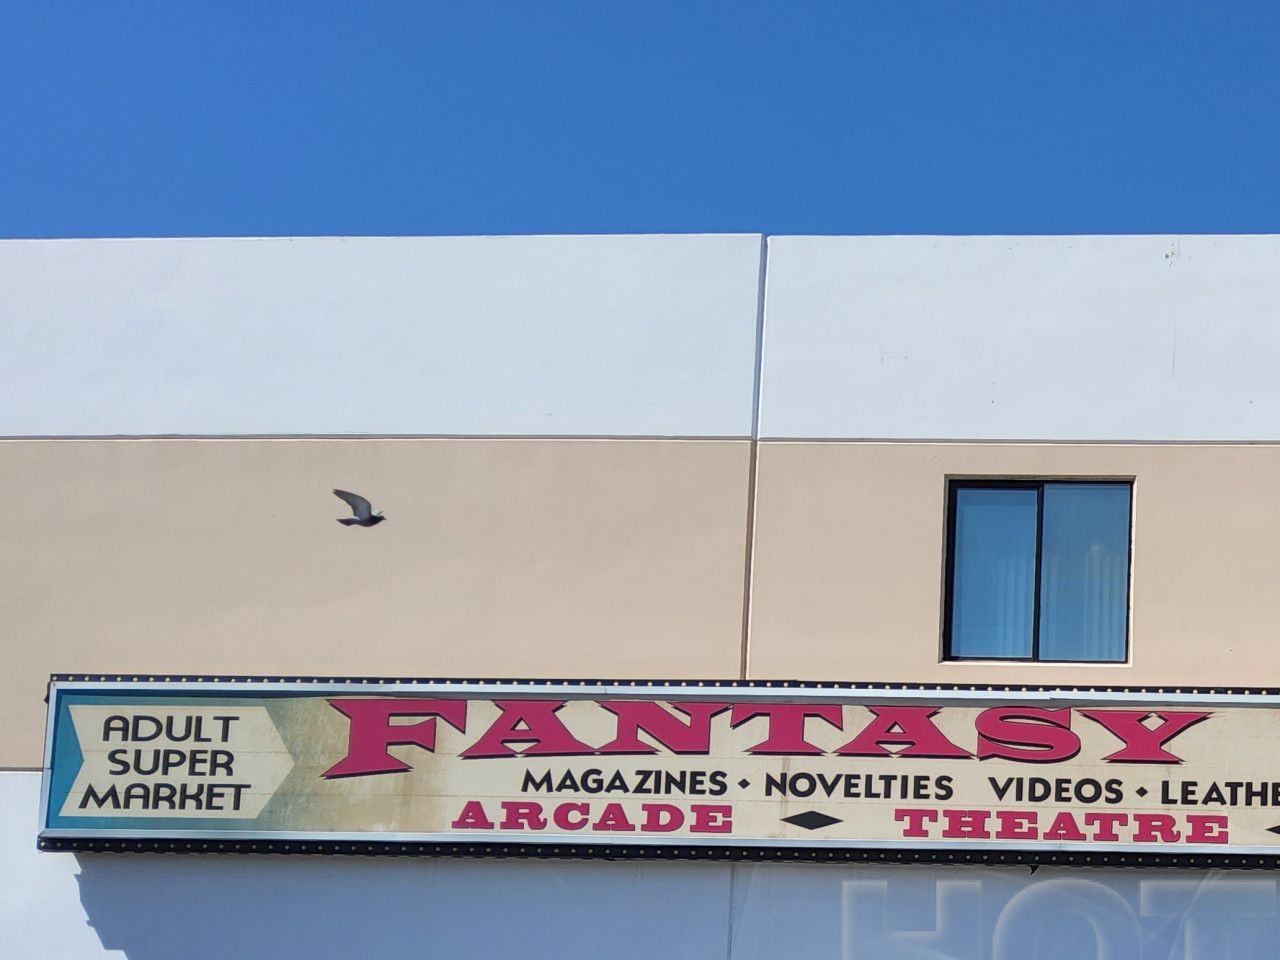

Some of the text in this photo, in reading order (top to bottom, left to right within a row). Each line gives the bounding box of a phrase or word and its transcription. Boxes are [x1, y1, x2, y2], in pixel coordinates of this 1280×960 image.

[103, 715, 240, 742] ADULT
[319, 698, 1211, 779] FANTASY
[108, 748, 234, 776] SUPER
[79, 783, 251, 811] MARKET
[521, 769, 728, 796] MAGAZINES
[765, 771, 955, 801] NOVELTIES
[988, 776, 1124, 804] VIDEOS
[451, 800, 733, 834] ARCADE
[894, 809, 1229, 844] THEATRE
